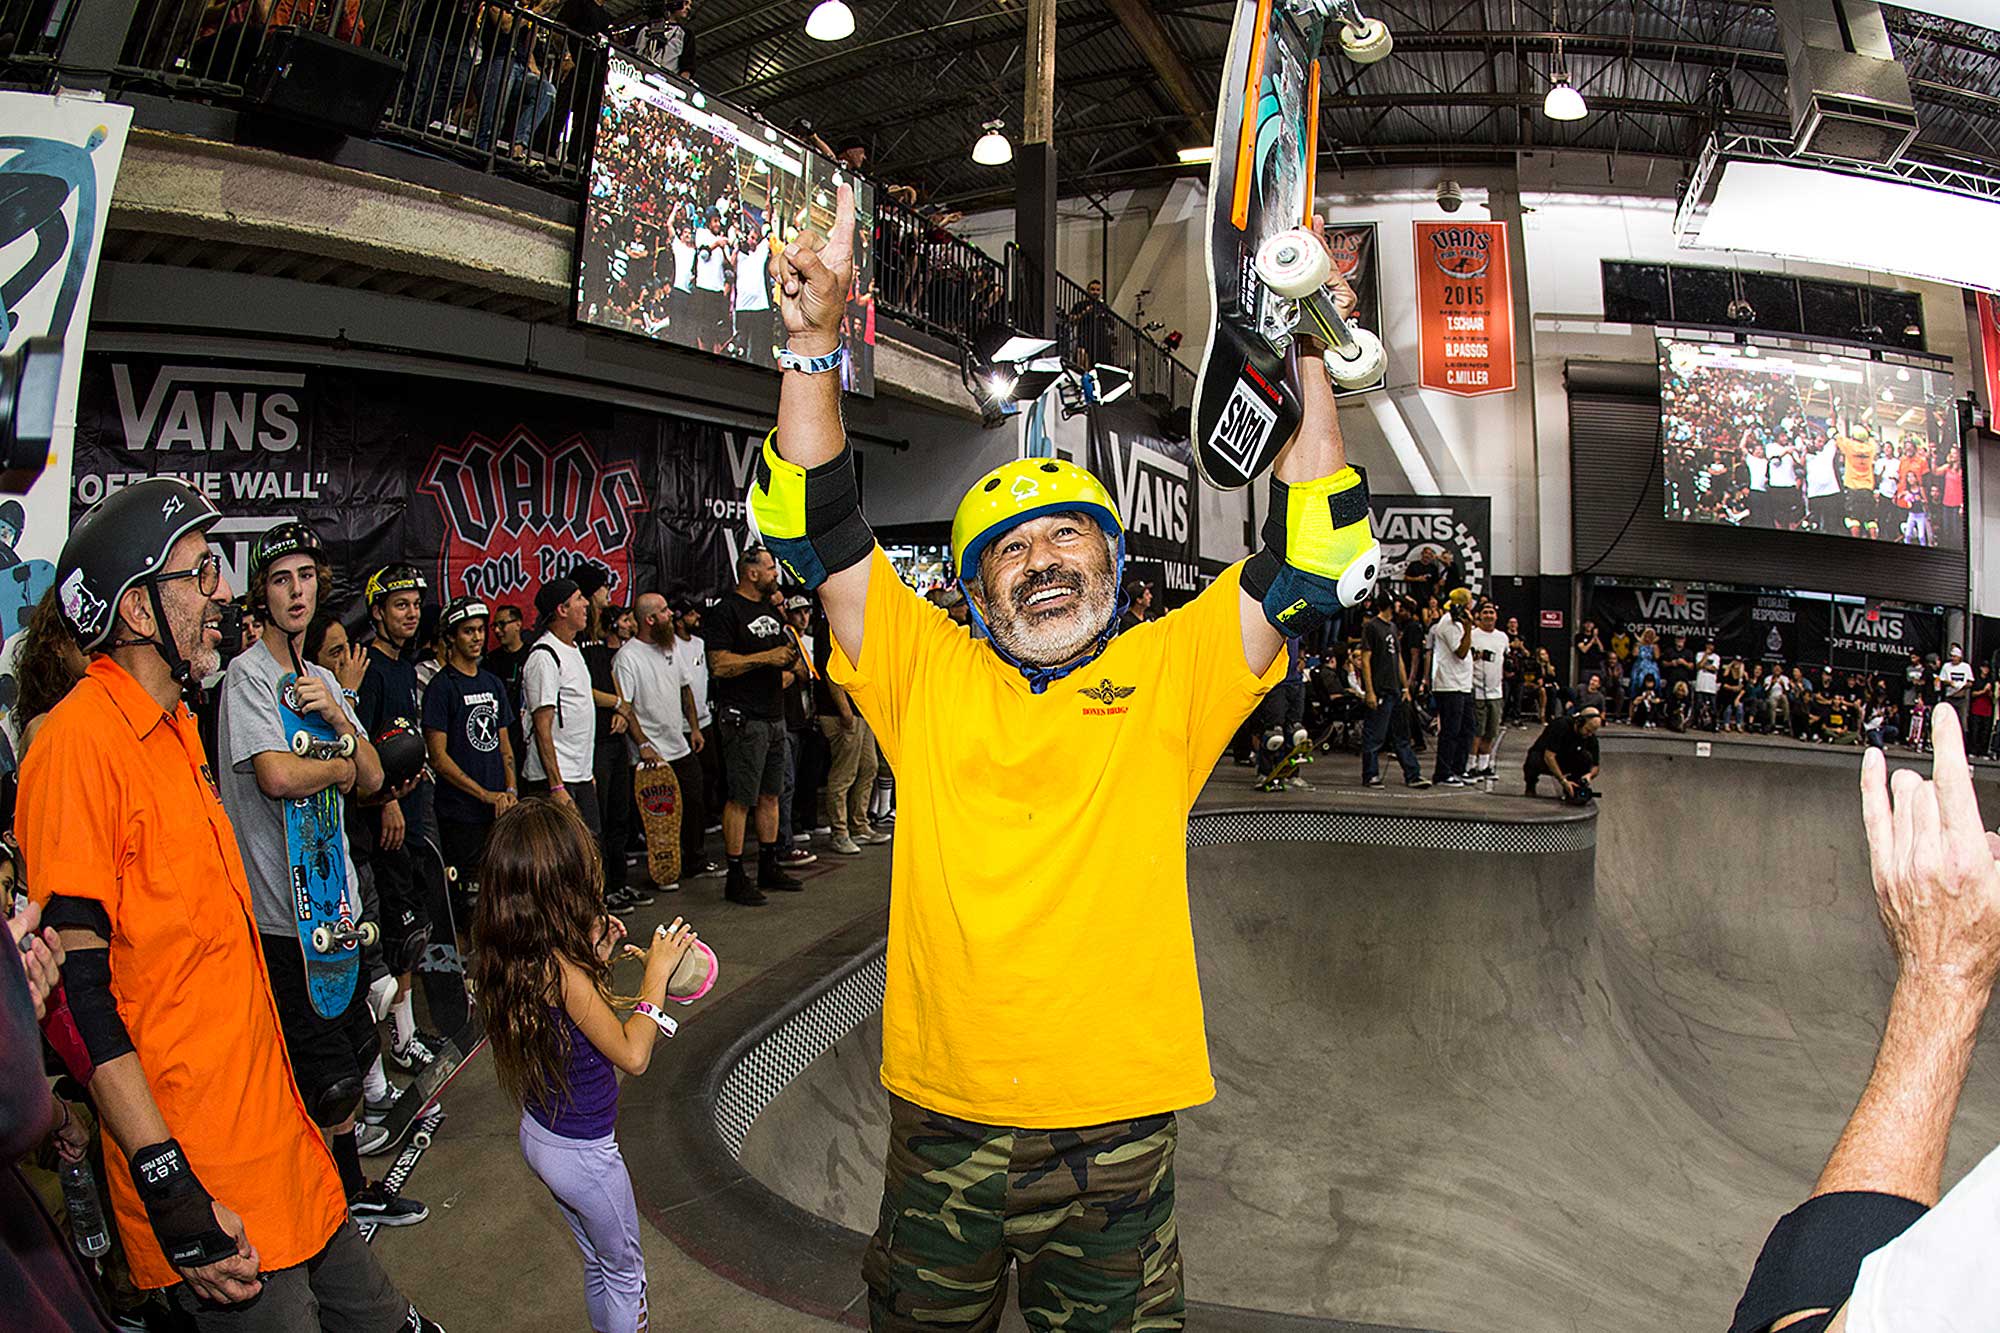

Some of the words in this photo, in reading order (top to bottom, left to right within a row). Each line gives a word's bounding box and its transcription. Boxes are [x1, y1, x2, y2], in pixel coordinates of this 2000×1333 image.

[1430, 228, 1491, 250] VANS
[1444, 286, 1485, 305] 2015
[1445, 343, 1489, 358] B.PASSOS
[1447, 369, 1489, 385] C.MILLER
[112, 363, 306, 451] VANS
[1213, 394, 1267, 473] VANS
[230, 471, 328, 500] WALL"
[427, 433, 645, 556] VANS
[1109, 431, 1189, 544] VANS
[704, 498, 746, 519] "OFF
[1369, 506, 1454, 541] VANS
[460, 546, 532, 600] POOL
[1635, 591, 1705, 620] VANS
[1838, 606, 1904, 640] VANS
[1854, 640, 1877, 652] THE
[147, 1159, 180, 1183] 187
